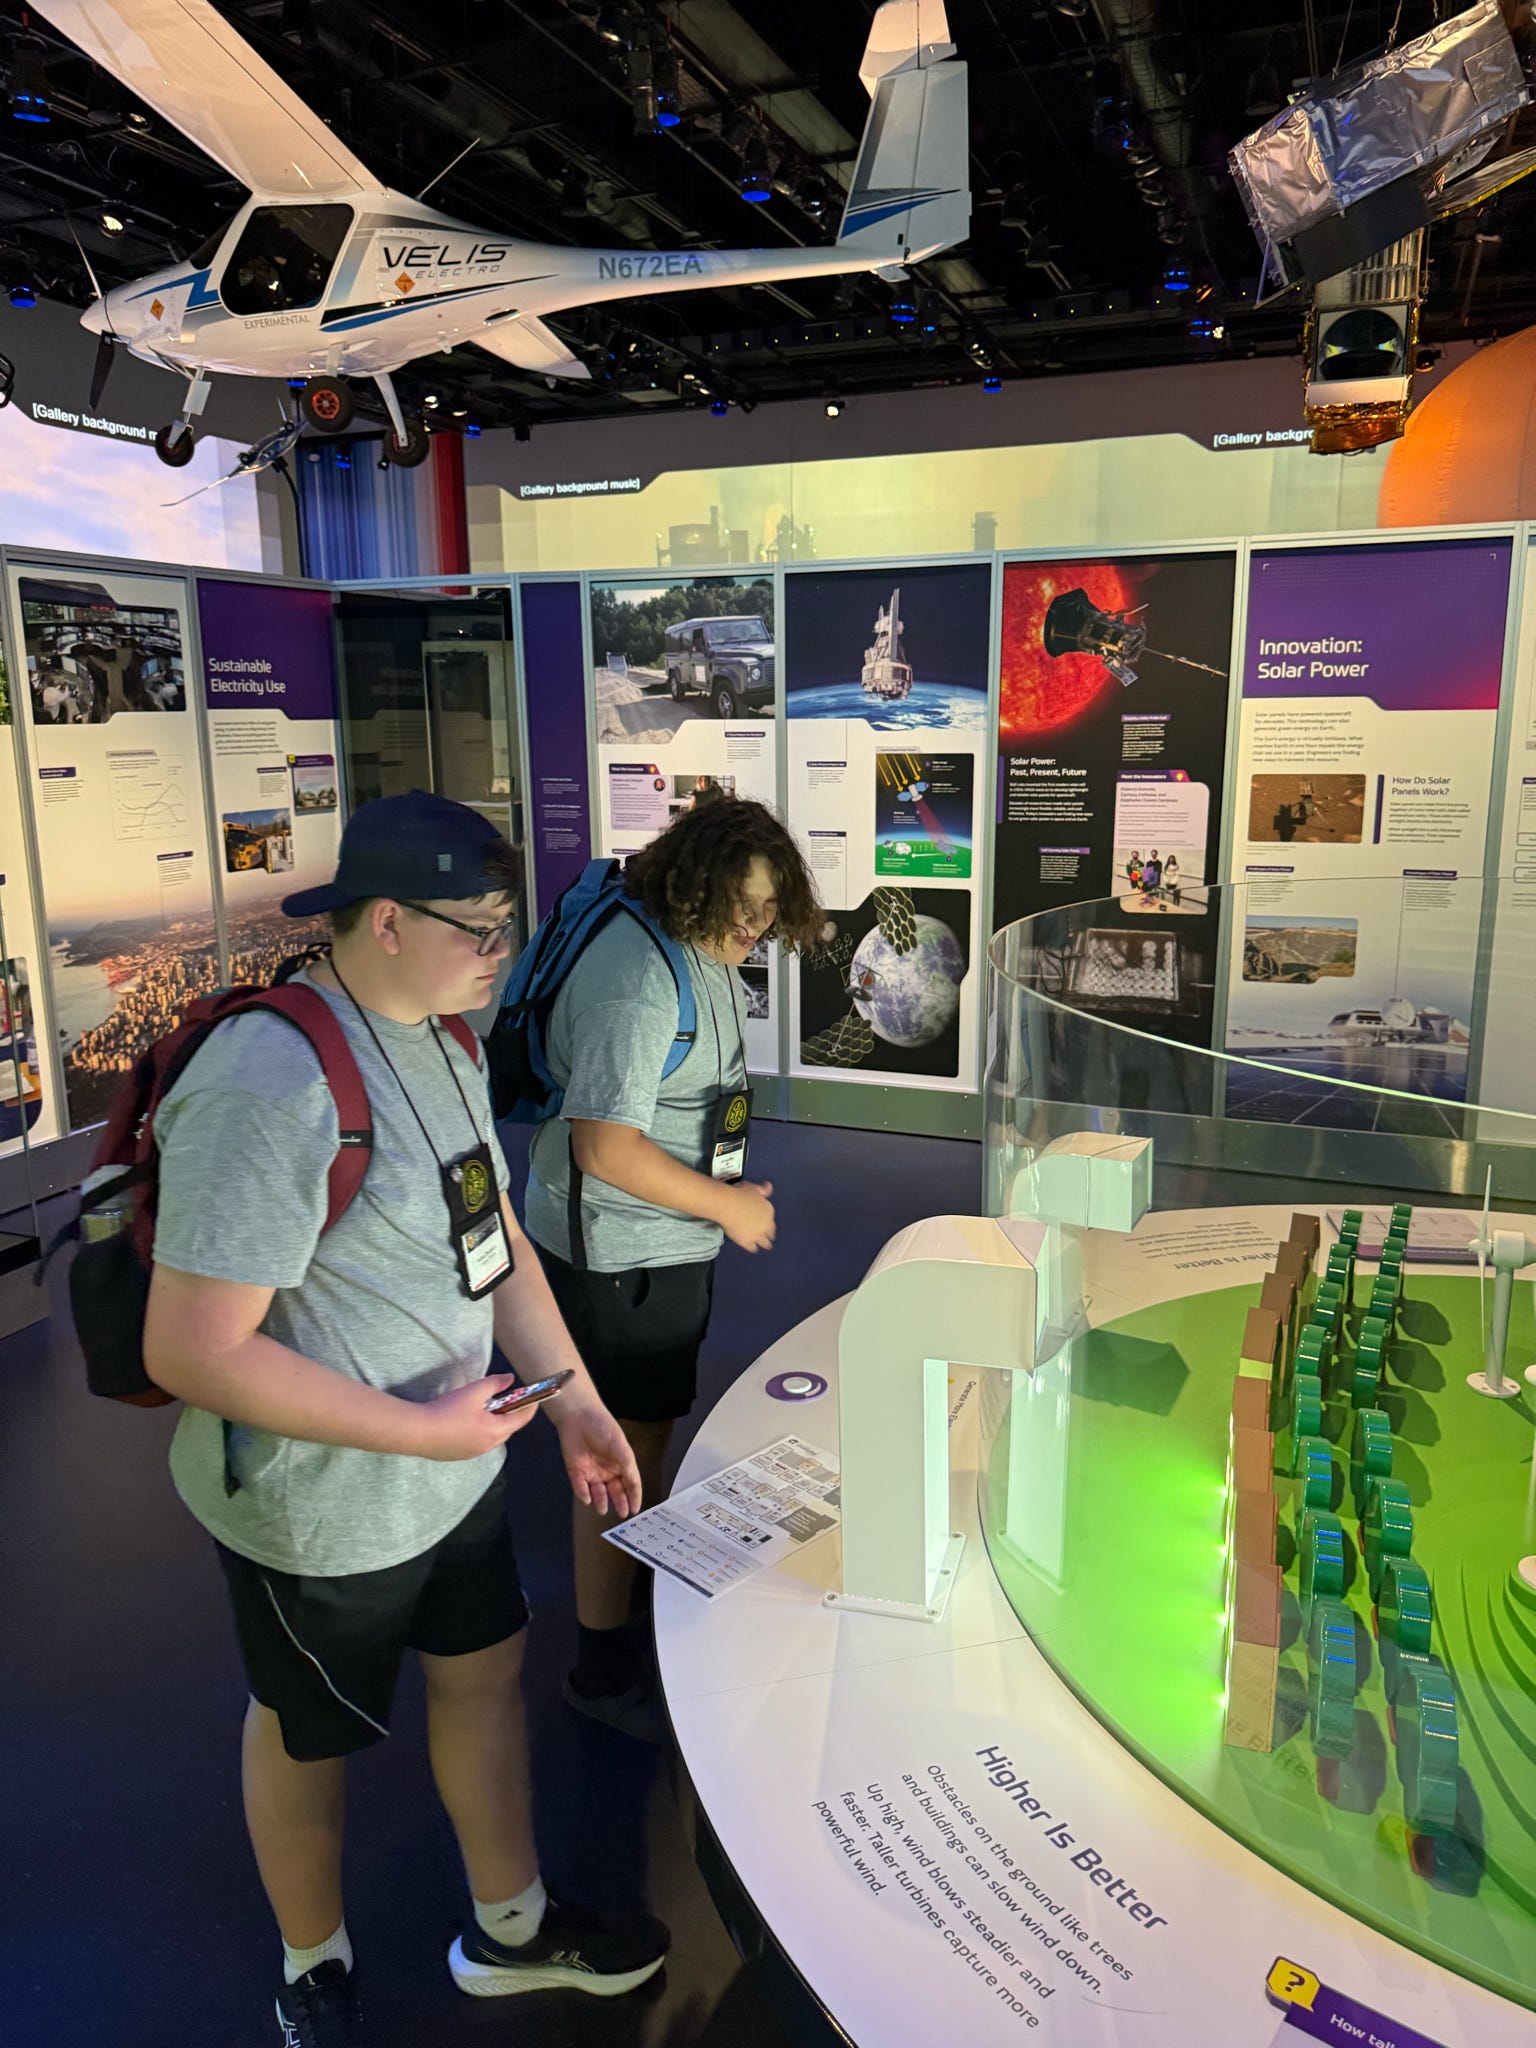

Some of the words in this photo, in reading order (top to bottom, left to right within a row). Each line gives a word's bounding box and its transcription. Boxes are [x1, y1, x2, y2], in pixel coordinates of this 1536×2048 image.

[383, 244, 512, 267] VELIS
[415, 264, 500, 279] ELECTRO
[599, 254, 703, 279] N672EA
[244, 315, 310, 330] EXPERIMENTAL
[32, 403, 79, 426] [Gallery
[82, 414, 147, 439] background
[1213, 433, 1262, 447] [Gallery
[521, 484, 555, 497] [Gallery
[556, 480, 608, 494] background
[610, 478, 640, 490] music]
[1260, 637, 1362, 655] Innovation:
[208, 658, 272, 673] Sustainable
[1258, 662, 1305, 679] Solar
[1310, 661, 1369, 678] Power
[210, 678, 264, 695] Electricity
[265, 679, 286, 693] Use
[1010, 757, 1029, 765] Solar
[1031, 757, 1056, 766] Power:
[1010, 768, 1029, 777] Past,
[1030, 768, 1060, 777] Present,
[1062, 768, 1087, 776] Future
[1392, 776, 1412, 784] How
[1428, 776, 1451, 785] Solar
[1391, 787, 1420, 796] Panels
[1422, 787, 1450, 796] Work?
[975, 1745, 1052, 1820] Higher
[1044, 1822, 1076, 1849] Is
[1070, 1847, 1169, 1929] Better
[811, 1800, 862, 1858] powerful
[854, 1858, 887, 1896] wind.
[927, 1765, 978, 1826] Obstacles
[975, 1826, 993, 1844] on
[990, 1843, 1014, 1867] the
[1008, 1868, 1065, 1916] ground
[1060, 1914, 1089, 1942] like
[1089, 1941, 1133, 1981] trees
[867, 1783, 884, 1802] Up
[879, 1802, 905, 1835] high,
[902, 1835, 936, 1868] wind
[928, 1867, 966, 1909] blows
[962, 1909, 1023, 1967] steadier
[1019, 1969, 1056, 1999] and
[902, 1774, 927, 1797] and
[919, 1797, 968, 1854] buildings
[965, 1855, 991, 1881] can
[988, 1879, 1022, 1912] slow
[1020, 1913, 1061, 1948] wind
[1056, 1949, 1101, 1994] down.
[840, 1791, 872, 1832] faster.
[868, 1831, 900, 1869] Taller
[895, 1870, 946, 1928] turbines
[943, 1929, 998, 1987] capture
[996, 1986, 1039, 2028] more
[1330, 2014, 1366, 2039] How
